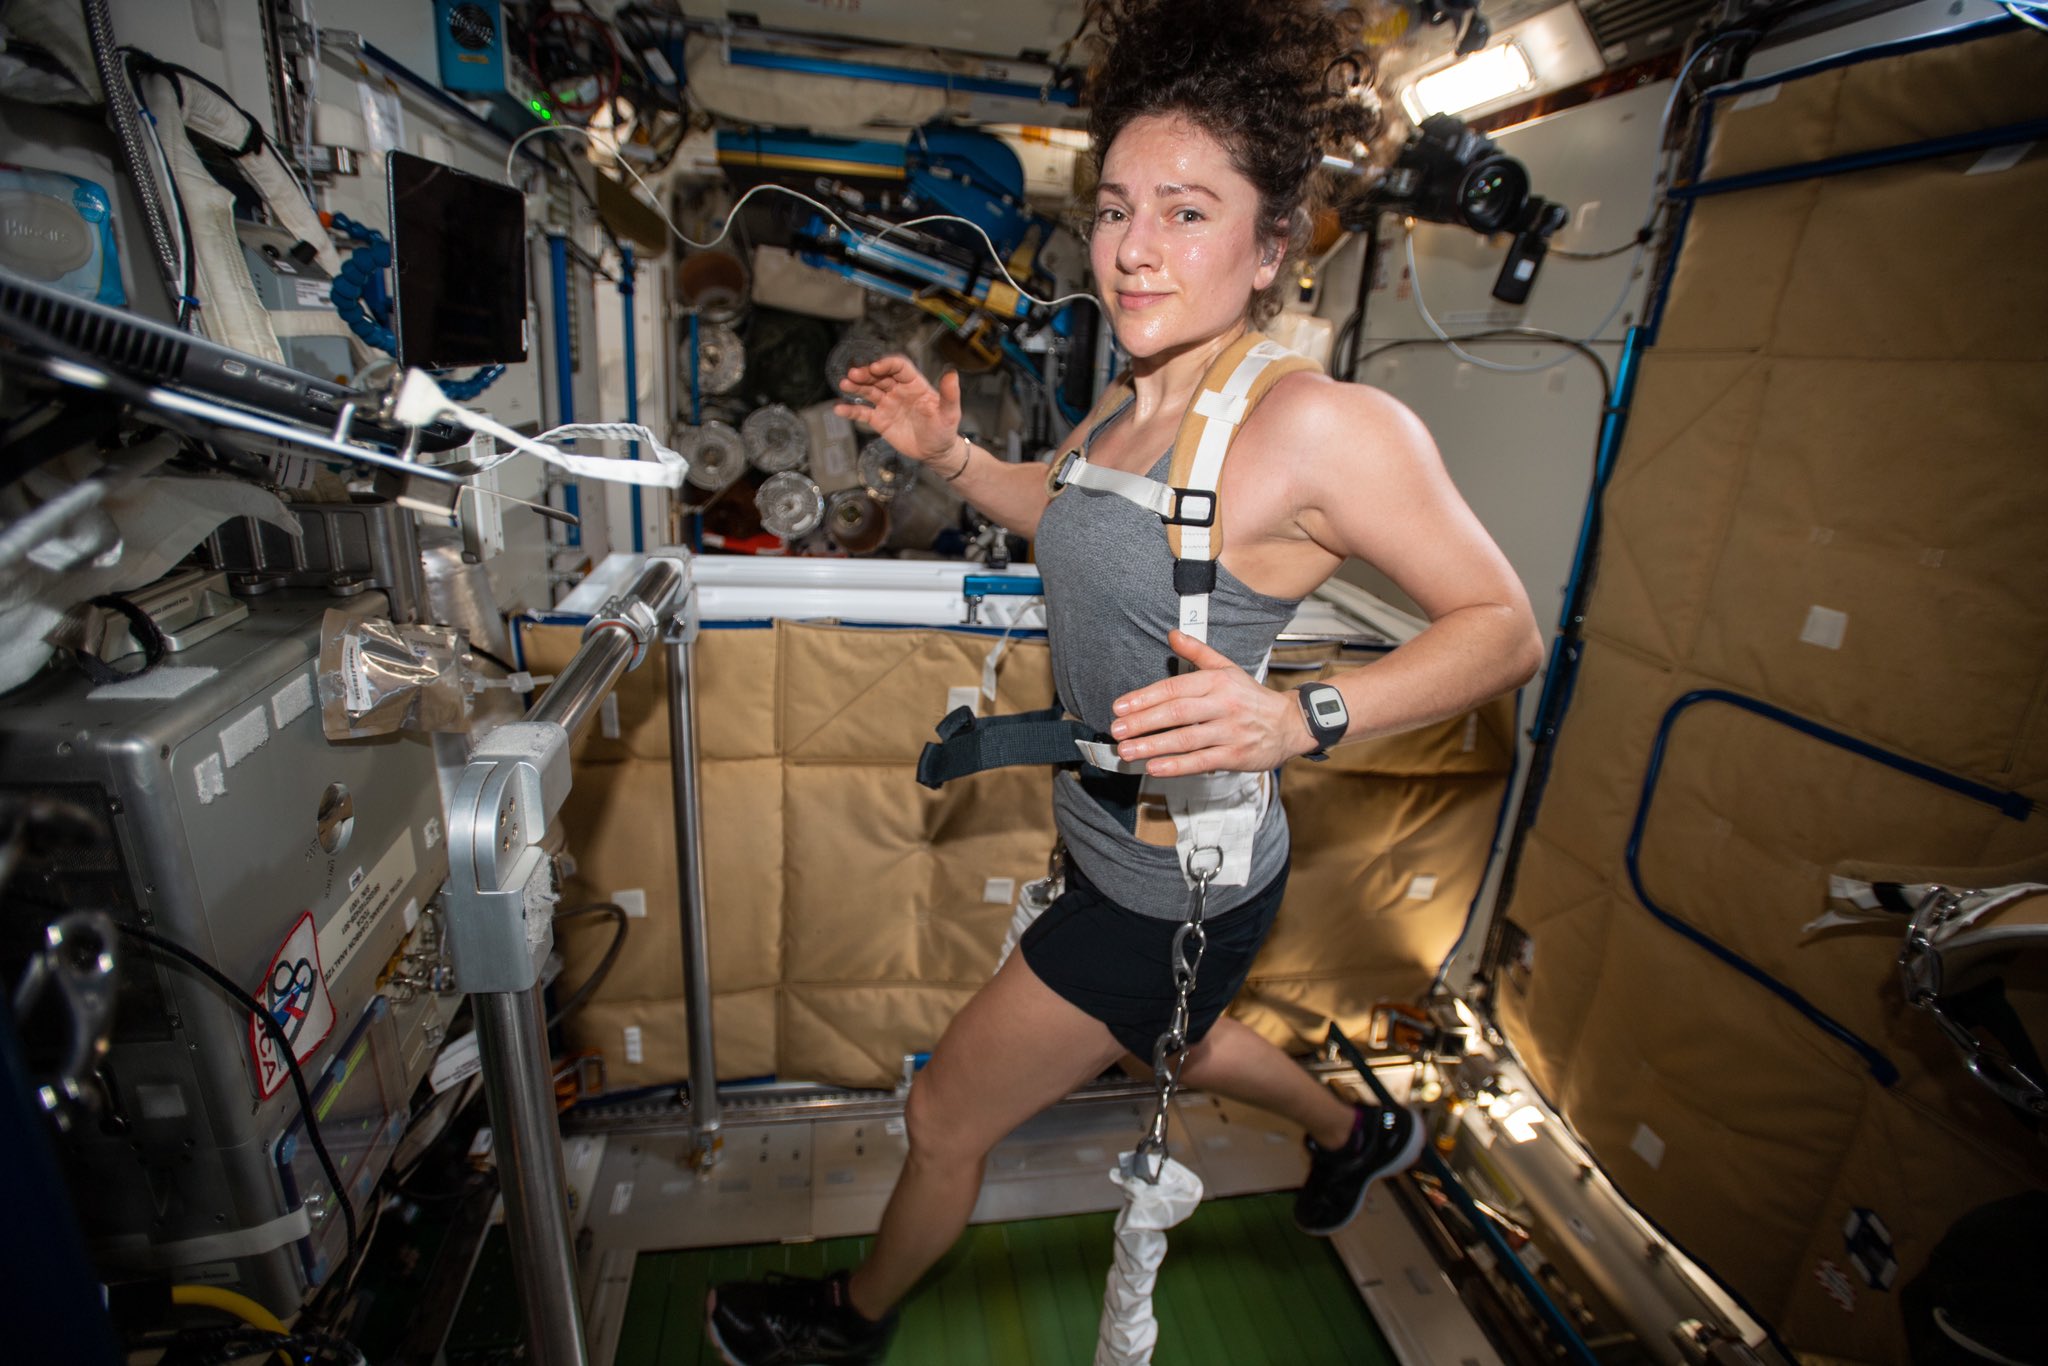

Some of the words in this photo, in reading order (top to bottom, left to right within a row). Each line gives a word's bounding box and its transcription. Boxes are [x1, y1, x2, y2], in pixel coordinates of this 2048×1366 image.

[1189, 609, 1198, 622] 2
[389, 877, 403, 894] TOTAL
[369, 893, 390, 923] ORGANIC
[347, 921, 370, 951] CARBON
[324, 949, 349, 981] ANALYZE
